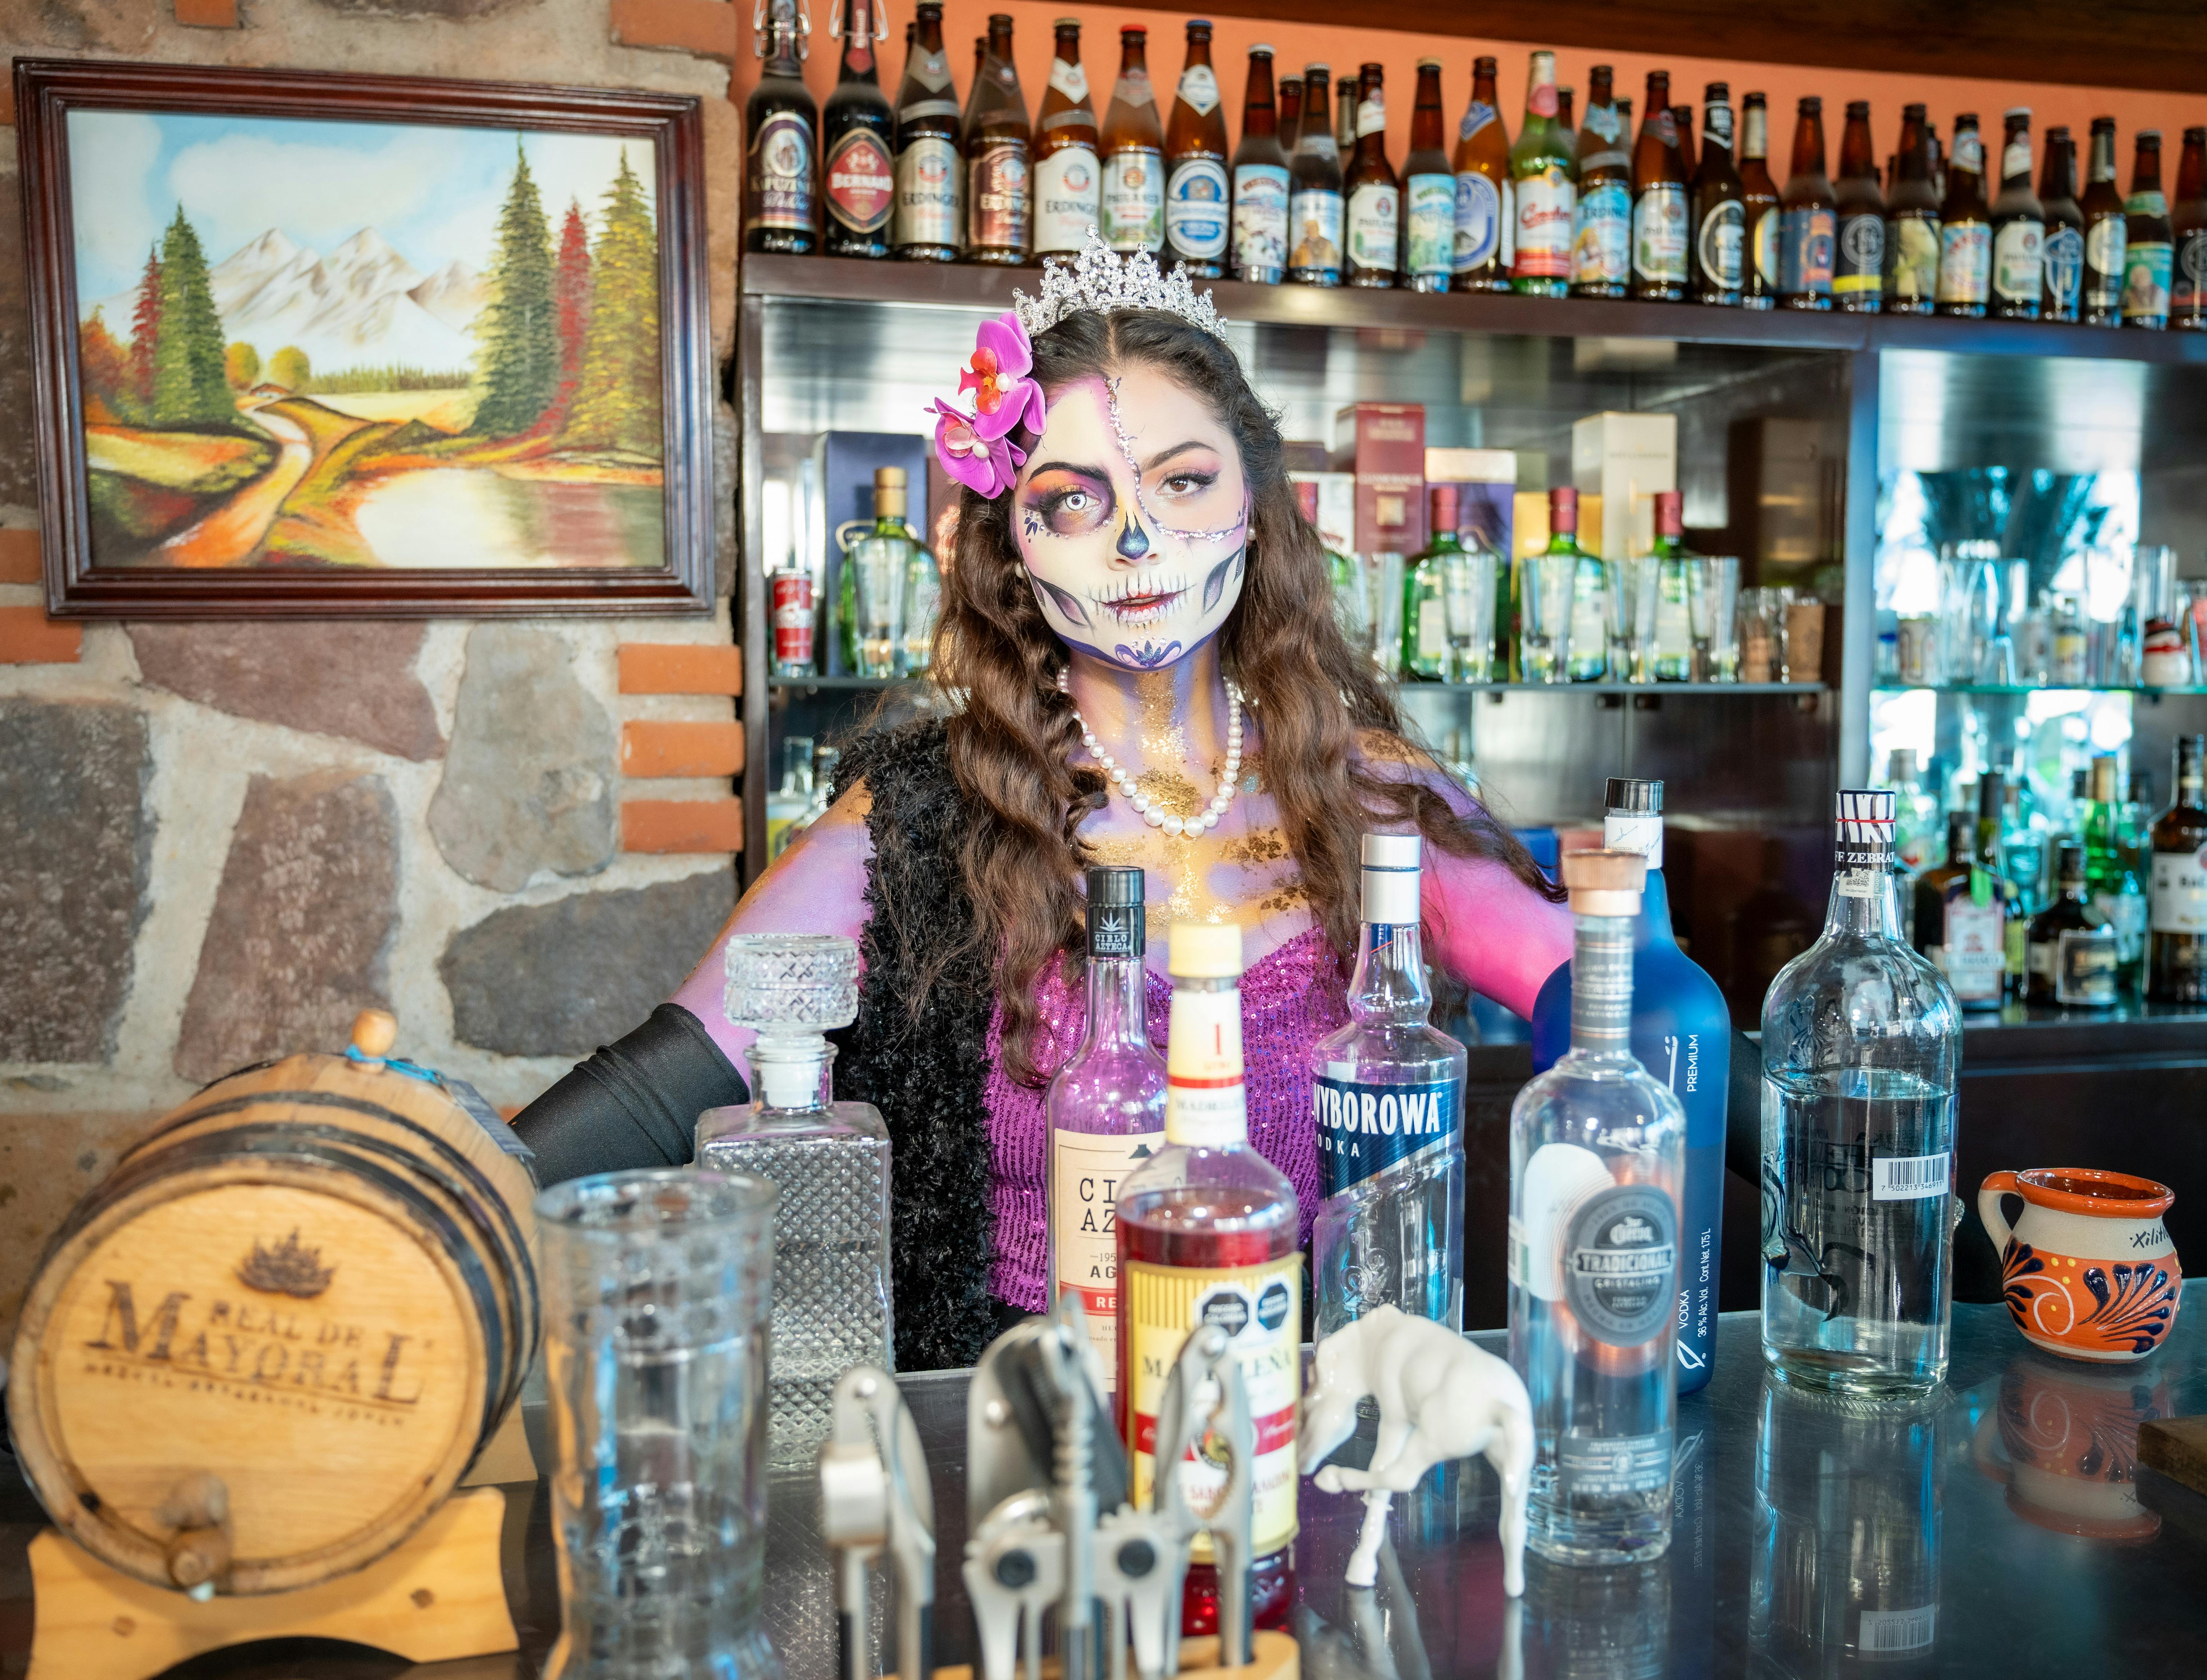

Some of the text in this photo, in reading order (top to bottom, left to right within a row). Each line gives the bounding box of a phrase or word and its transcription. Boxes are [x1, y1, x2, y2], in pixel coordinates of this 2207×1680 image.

[1095, 934, 1127, 942] CIELO
[1095, 942, 1128, 950] AZTECA
[1687, 1034, 1698, 1092] PREMIUM
[1315, 1133, 1360, 1158] ODKA
[1920, 1181, 1942, 1190] 346911
[1583, 1251, 1671, 1272] TRADICIONAL
[1700, 1248, 1710, 1263] Net.
[1700, 1264, 1709, 1282] Cont.
[1699, 1287, 1708, 1302] Vol.
[1678, 1289, 1690, 1329] VODKA
[1698, 1301, 1707, 1315] Alc.
[207, 1299, 365, 1348] REAL DE
[84, 1279, 428, 1405] MAYORAL
